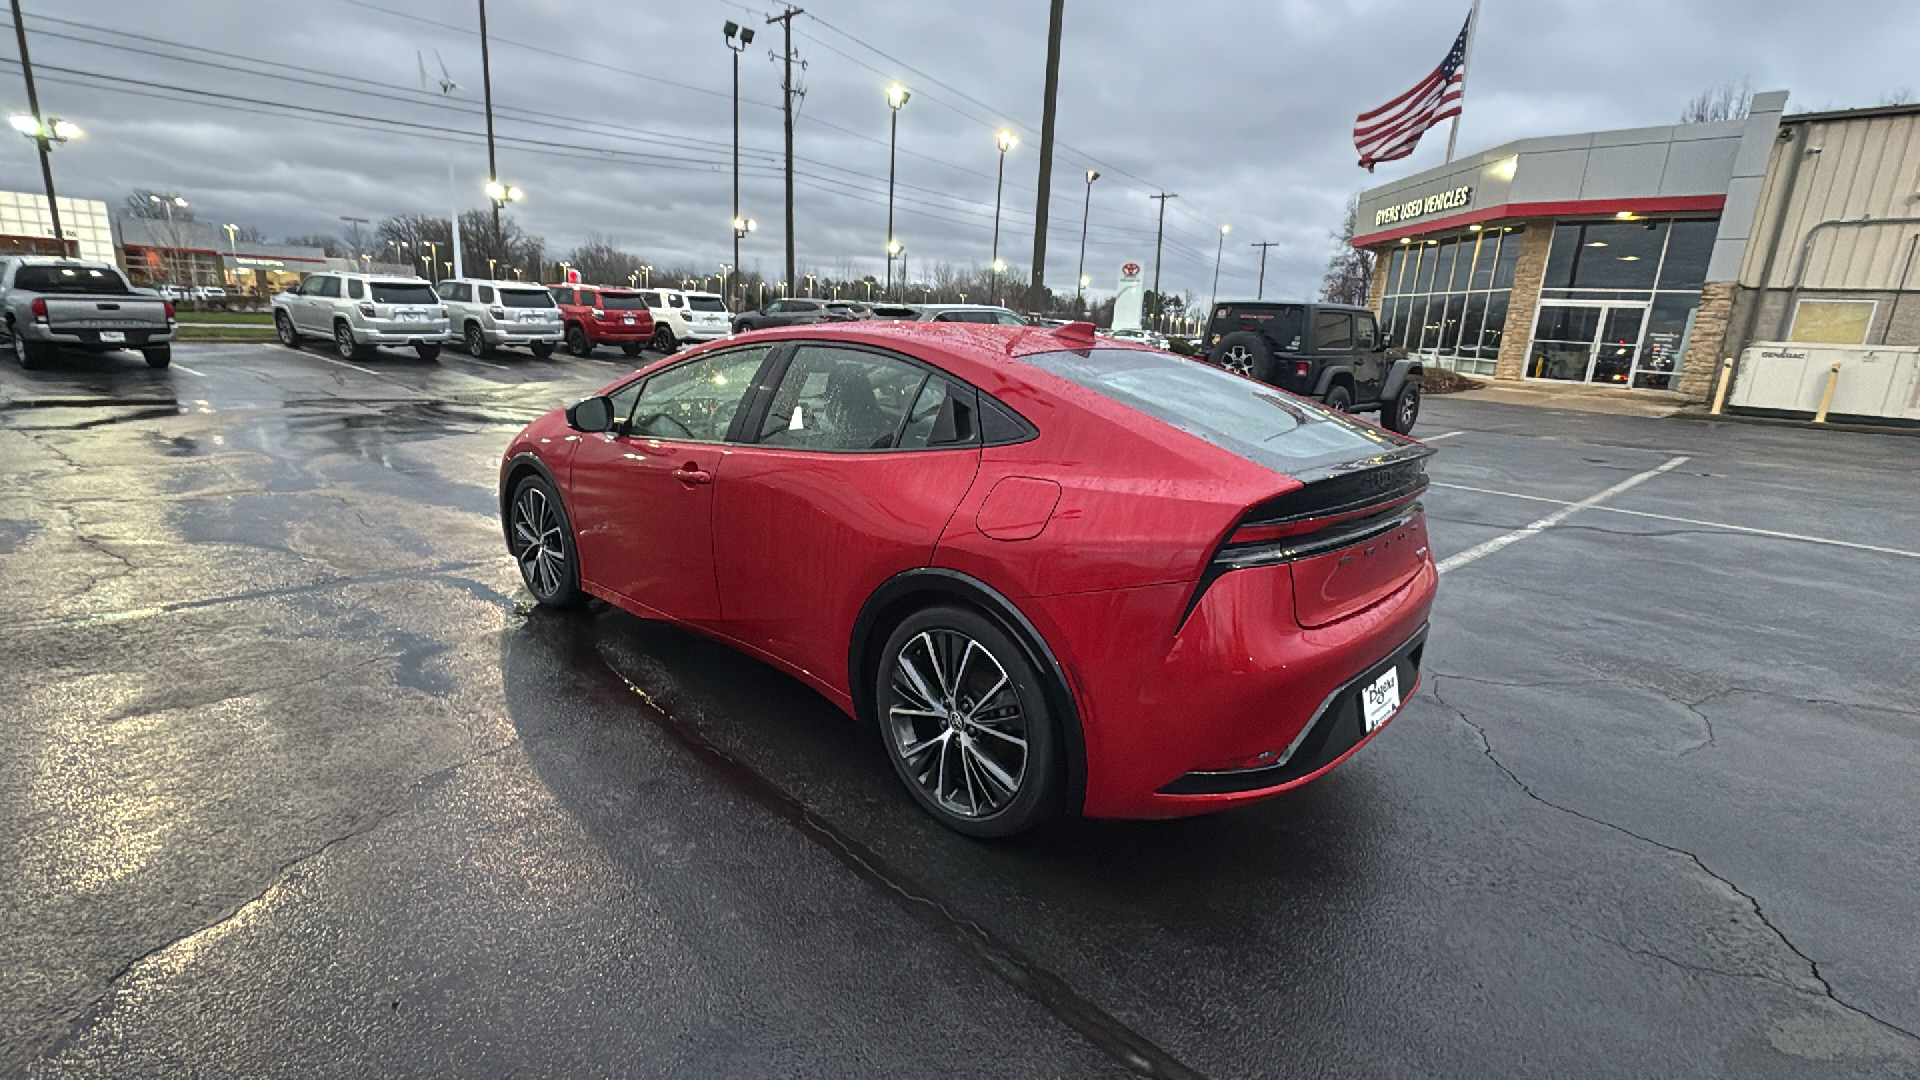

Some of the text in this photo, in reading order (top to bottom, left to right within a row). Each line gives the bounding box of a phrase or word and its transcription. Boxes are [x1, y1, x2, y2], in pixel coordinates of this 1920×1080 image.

[1376, 186, 1469, 226] BYERS USED VEHICLES
